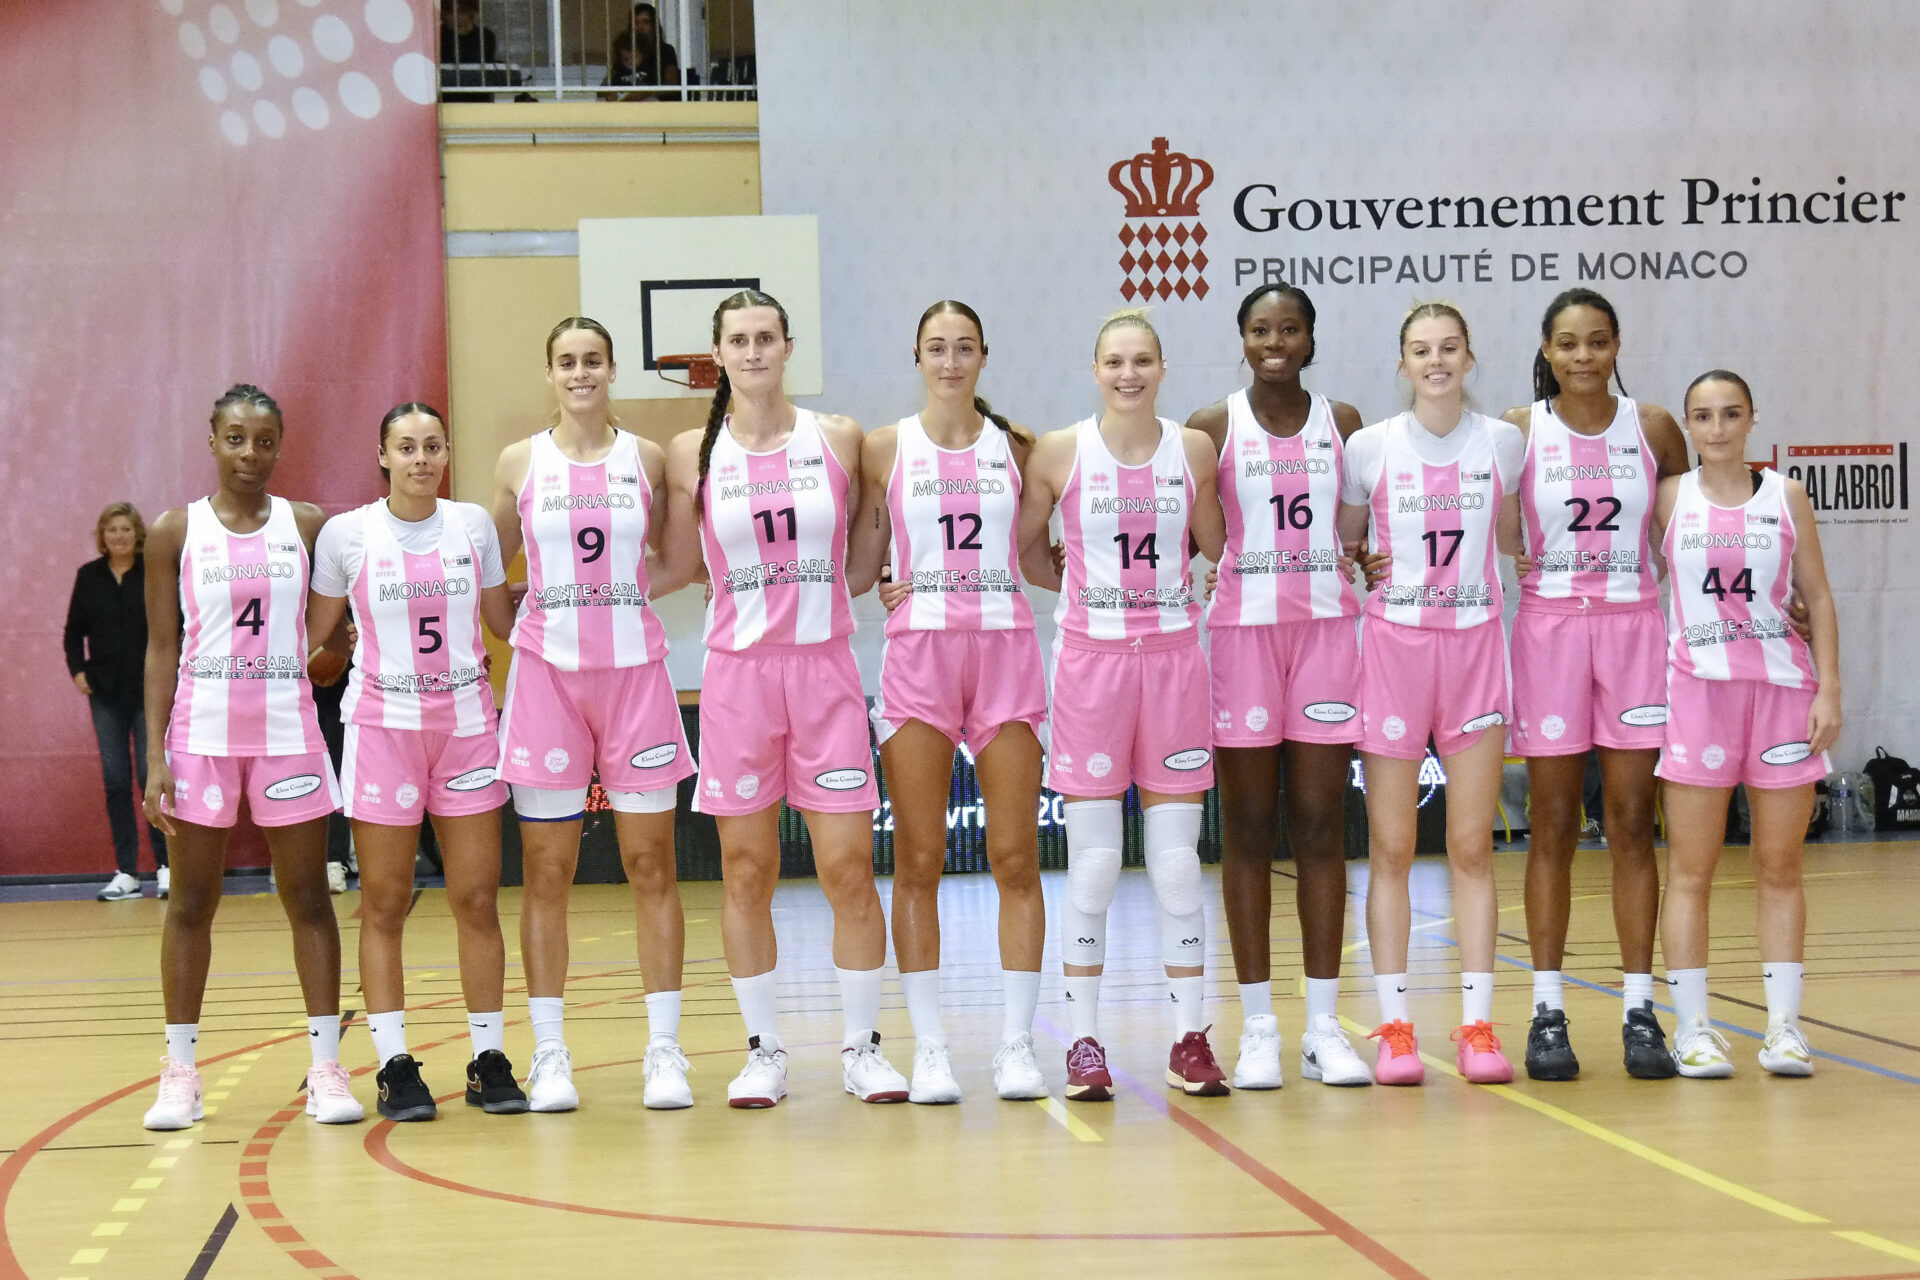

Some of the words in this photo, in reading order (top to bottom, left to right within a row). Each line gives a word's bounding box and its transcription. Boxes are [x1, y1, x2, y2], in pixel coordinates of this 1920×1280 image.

[1233, 181, 1665, 233] Gouvernement
[1681, 175, 1907, 226] Princier
[1234, 248, 1493, 288] PRINCIPAUTÉ
[1511, 255, 1560, 282] DE
[1577, 250, 1749, 281] MONACO
[1789, 446, 1892, 456] Entreprise
[1245, 458, 1330, 477] MONACO
[1544, 465, 1637, 483] MONACO
[721, 476, 819, 501] MONACO
[912, 478, 1005, 497] MONACO
[542, 493, 635, 513] MONACO
[1091, 497, 1181, 514] MONACO
[1269, 493, 1313, 530] 16
[1398, 492, 1485, 513] MONACO
[1564, 496, 1622, 532] 22
[753, 507, 796, 543] 11
[938, 513, 983, 550] 12
[577, 527, 605, 564] 9
[1113, 532, 1160, 569] 14
[1421, 530, 1465, 567] 17
[1681, 533, 1772, 550] MONACO
[1234, 550, 1291, 566] MONTE
[1298, 549, 1337, 564] CARL
[1536, 550, 1591, 565] MONTE
[1598, 550, 1641, 565] CARL
[202, 562, 294, 585] MONACO
[723, 561, 779, 587] MONTE
[785, 558, 836, 574] CARLO
[911, 569, 960, 585] ONTE
[1232, 565, 1269, 575] SOCIÉTÉ
[1271, 565, 1289, 574] DES
[1292, 564, 1319, 573] BAINS
[1320, 564, 1333, 572] DE
[1590, 564, 1618, 573] BAINS
[379, 577, 470, 602] MONACO
[760, 577, 778, 586] DES
[780, 575, 808, 584] BAINS
[809, 574, 822, 583] DE
[940, 584, 958, 593] DES
[961, 584, 989, 593] BAINS
[1701, 567, 1757, 602] 44
[535, 583, 593, 602] MONTE
[599, 582, 641, 598] CARL
[1079, 586, 1138, 602] MONTE
[1144, 585, 1190, 601] CARLO
[1381, 583, 1438, 599] MONTE
[1445, 583, 1492, 600] CARLO
[573, 598, 591, 607] DES
[593, 598, 621, 606] BAINS
[1119, 601, 1137, 609] DES
[1417, 599, 1435, 608] DES
[1438, 599, 1465, 608] BAINS
[236, 598, 265, 636] 4
[418, 616, 443, 654] 5
[1719, 633, 1738, 643] DES
[187, 655, 246, 671] MONTE
[225, 671, 243, 680] DES
[247, 671, 276, 680] BAINS
[277, 671, 290, 680] DE
